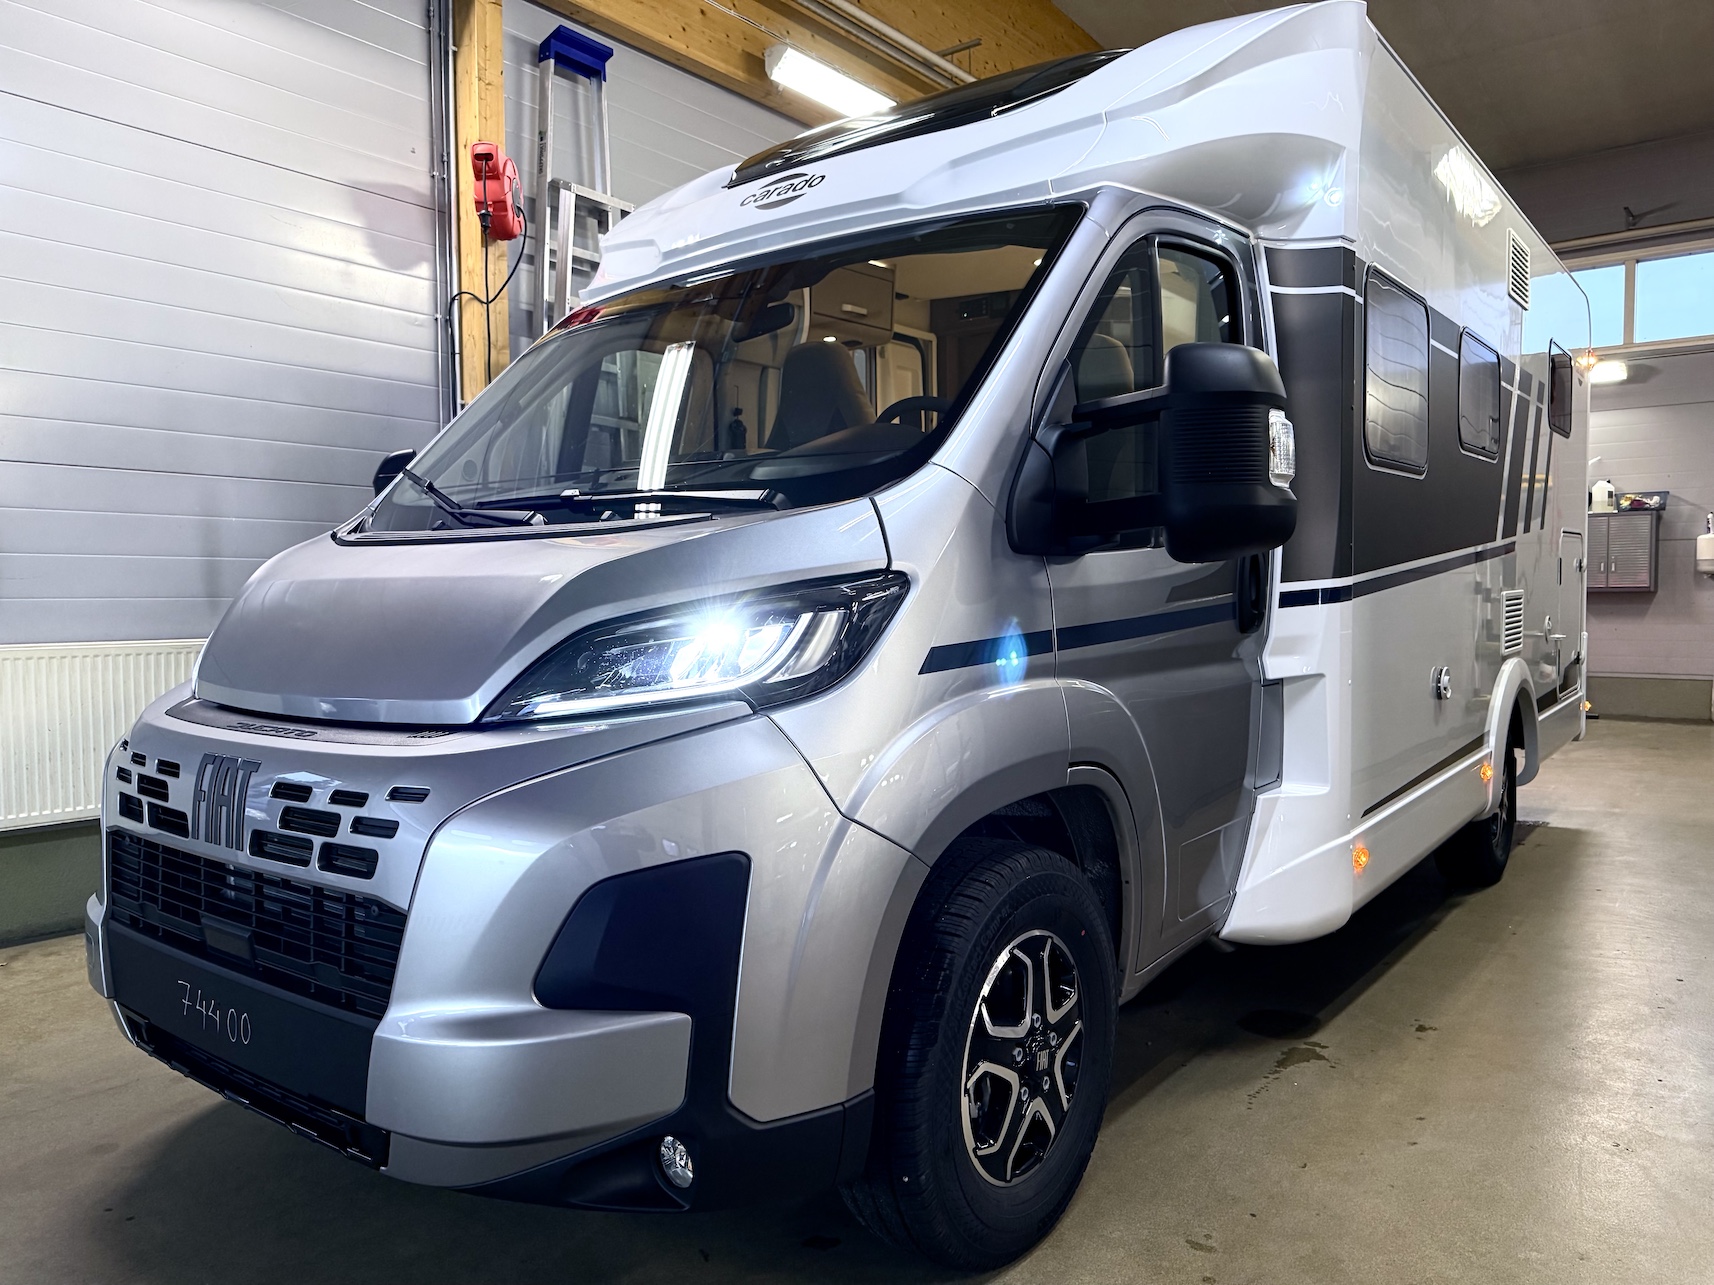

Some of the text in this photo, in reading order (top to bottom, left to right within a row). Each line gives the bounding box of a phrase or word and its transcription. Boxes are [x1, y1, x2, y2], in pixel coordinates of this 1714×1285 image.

[740, 174, 826, 207] carado
[226, 722, 318, 738] DUCATO
[191, 752, 262, 852] FIAT
[177, 980, 251, 1045] 74400
[1035, 1048, 1050, 1072] FIAT
